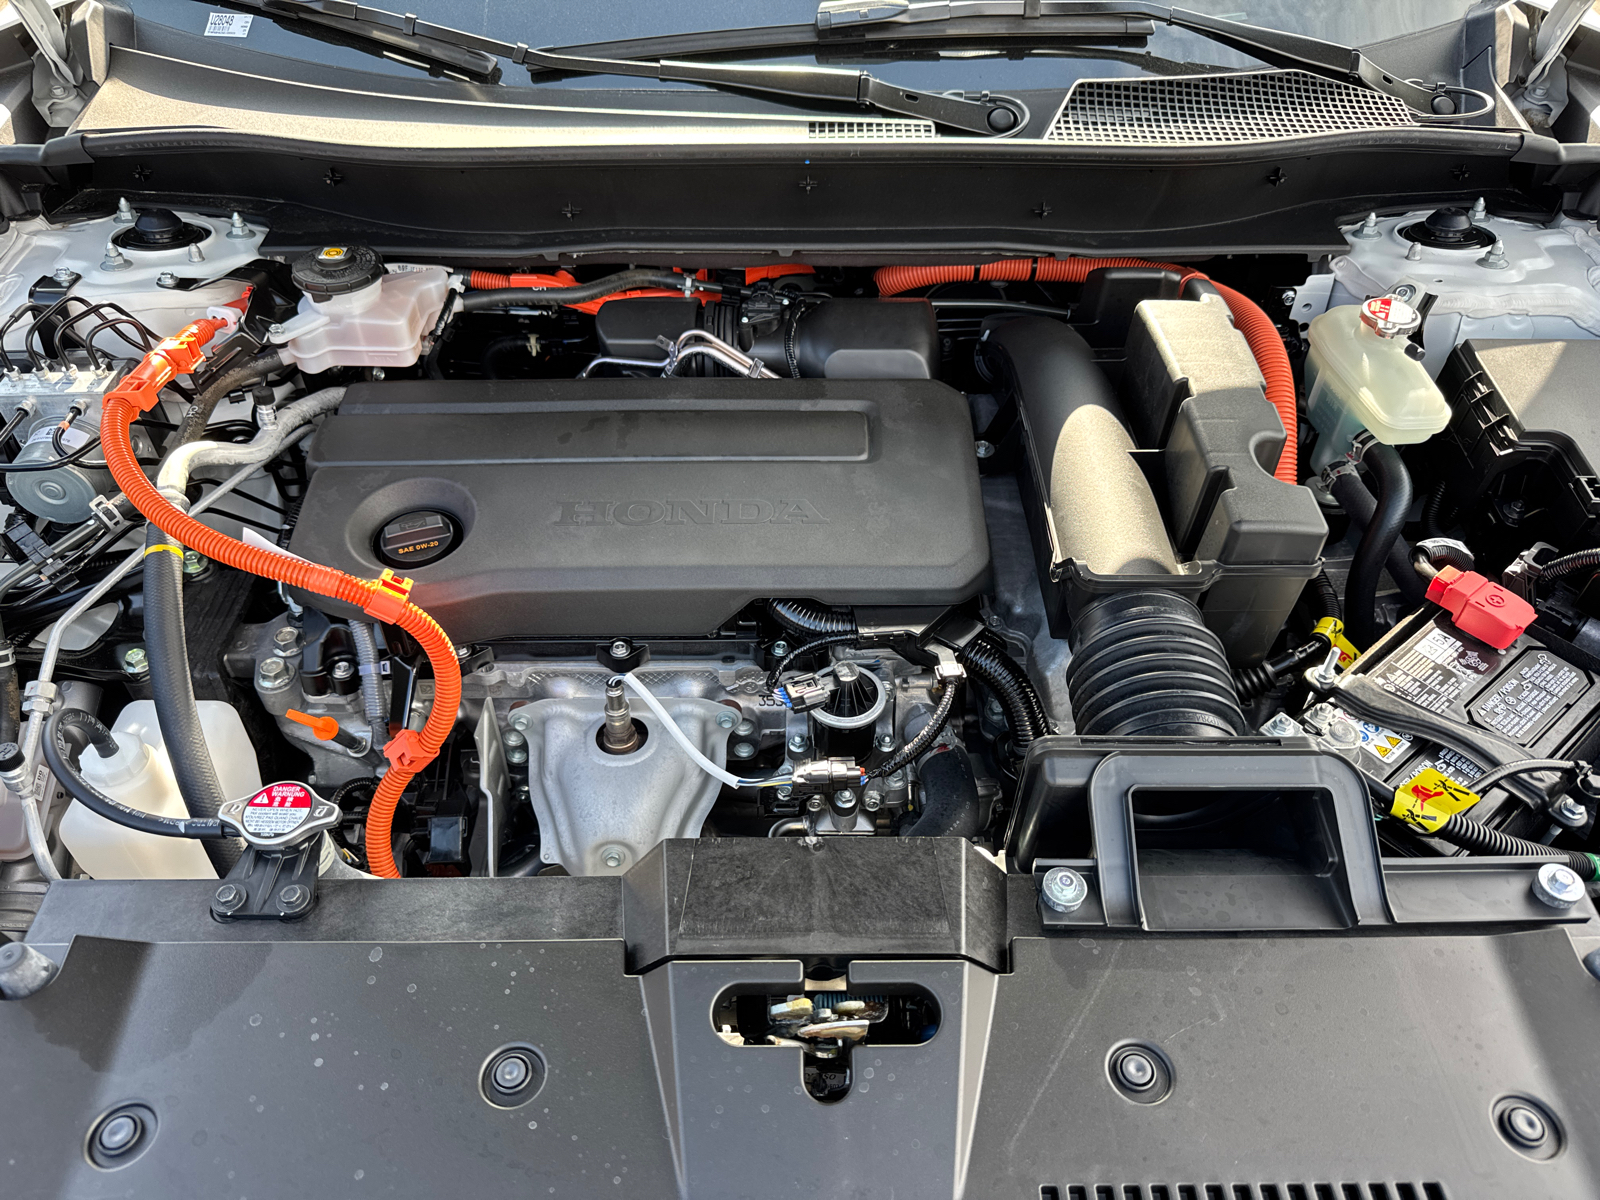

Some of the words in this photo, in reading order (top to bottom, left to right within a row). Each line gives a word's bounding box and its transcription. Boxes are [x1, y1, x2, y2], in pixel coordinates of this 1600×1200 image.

[553, 499, 830, 526] HONDA
[398, 545, 415, 554] SAE
[415, 541, 439, 550] 0W-20
